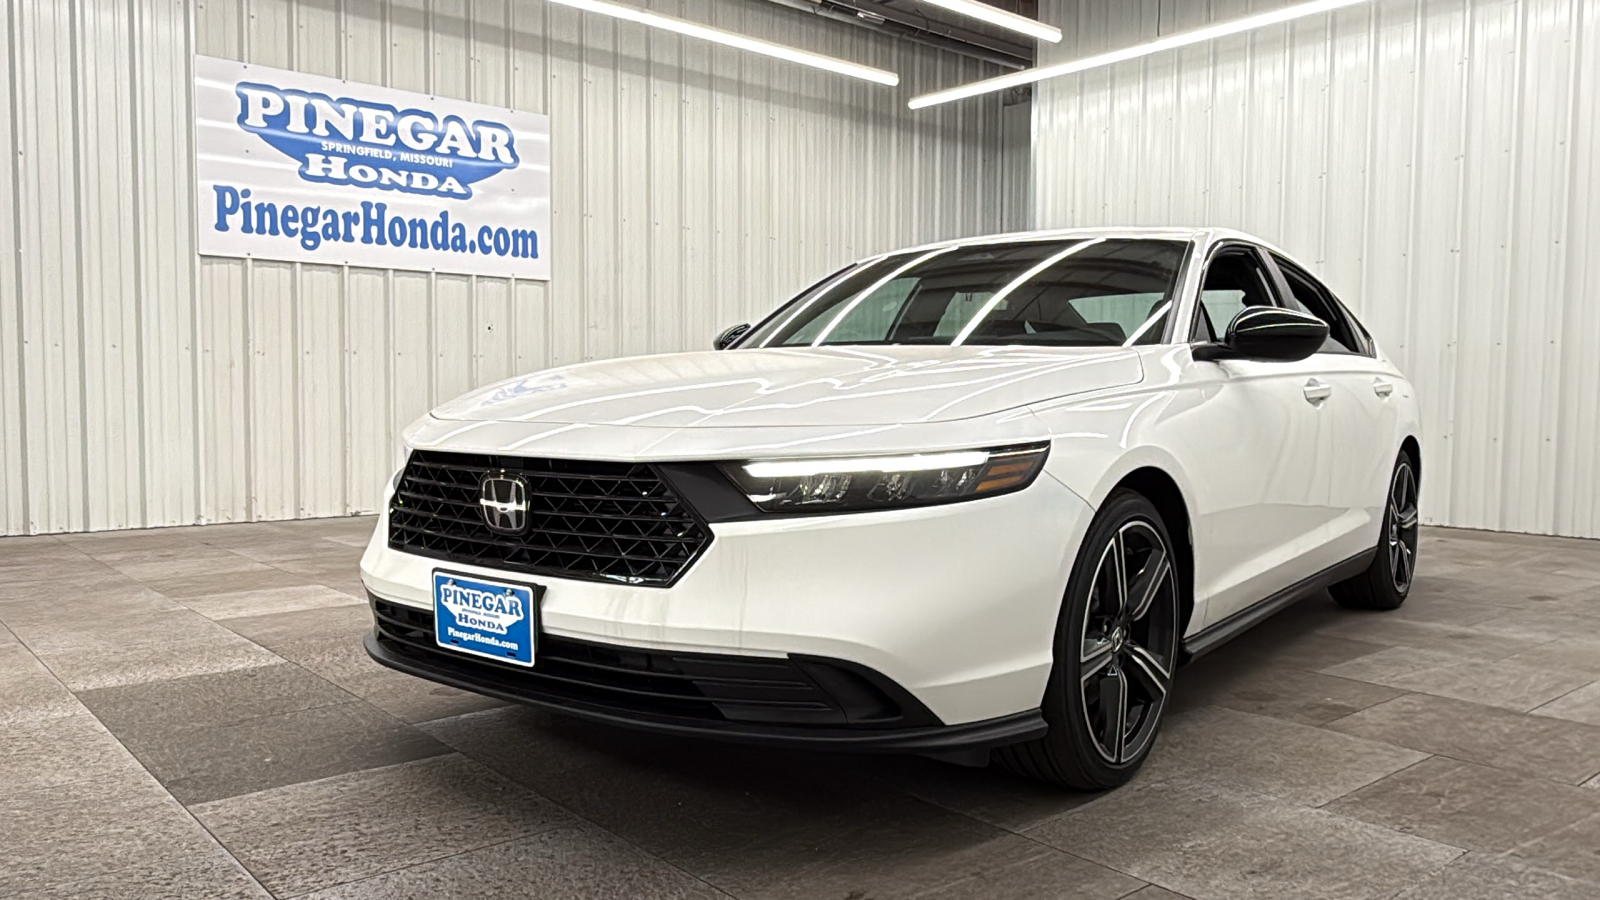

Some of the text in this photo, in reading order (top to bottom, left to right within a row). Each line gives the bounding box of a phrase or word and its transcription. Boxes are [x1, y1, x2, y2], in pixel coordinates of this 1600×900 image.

[240, 86, 516, 165] PINEGAR
[321, 141, 453, 168] SPRINGFIELD, MISSOURI
[304, 153, 468, 194] HONDA
[212, 184, 539, 260] PinegarHonda.com
[442, 587, 521, 617] PINEGAR
[457, 613, 504, 631] HONDA
[447, 627, 518, 651] PinegarHonda.com
